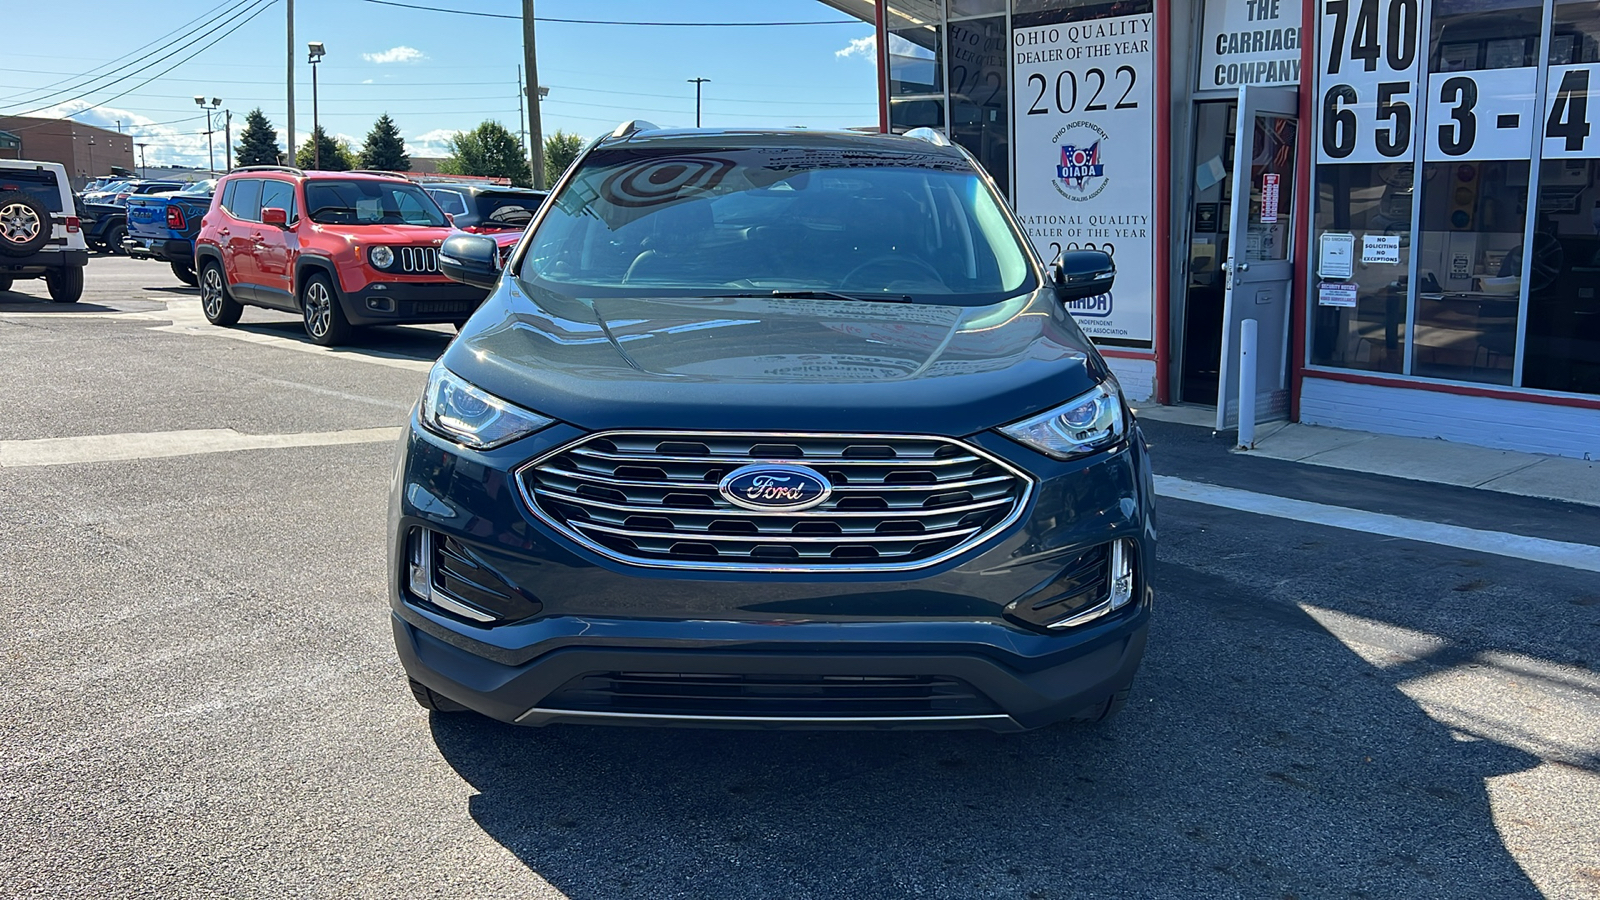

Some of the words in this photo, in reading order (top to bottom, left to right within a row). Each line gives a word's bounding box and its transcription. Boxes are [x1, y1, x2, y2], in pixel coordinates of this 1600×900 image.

[1247, 0, 1280, 21] THE
[1015, 28, 1059, 46] OHIO
[1068, 18, 1151, 43] QUALITY
[1326, 0, 1417, 75] 740
[1017, 49, 1063, 64] DEALER
[1066, 47, 1082, 60] OF
[1086, 43, 1111, 58] THE
[1114, 40, 1149, 55] YEAR
[1214, 59, 1301, 86] COMPANY
[1027, 65, 1138, 115] 2022
[1051, 127, 1066, 144] OHIO
[1066, 121, 1110, 141] INDEPENDENT
[1062, 165, 1096, 177] OIADA
[1020, 215, 1084, 225] NATIONAL
[1088, 215, 1148, 226] QUALITY
[1028, 228, 1063, 238] EALER
[1067, 228, 1082, 238] OF
[1086, 228, 1110, 238] THE
[1115, 228, 1147, 239] YEAR
[740, 475, 805, 500] Ford
